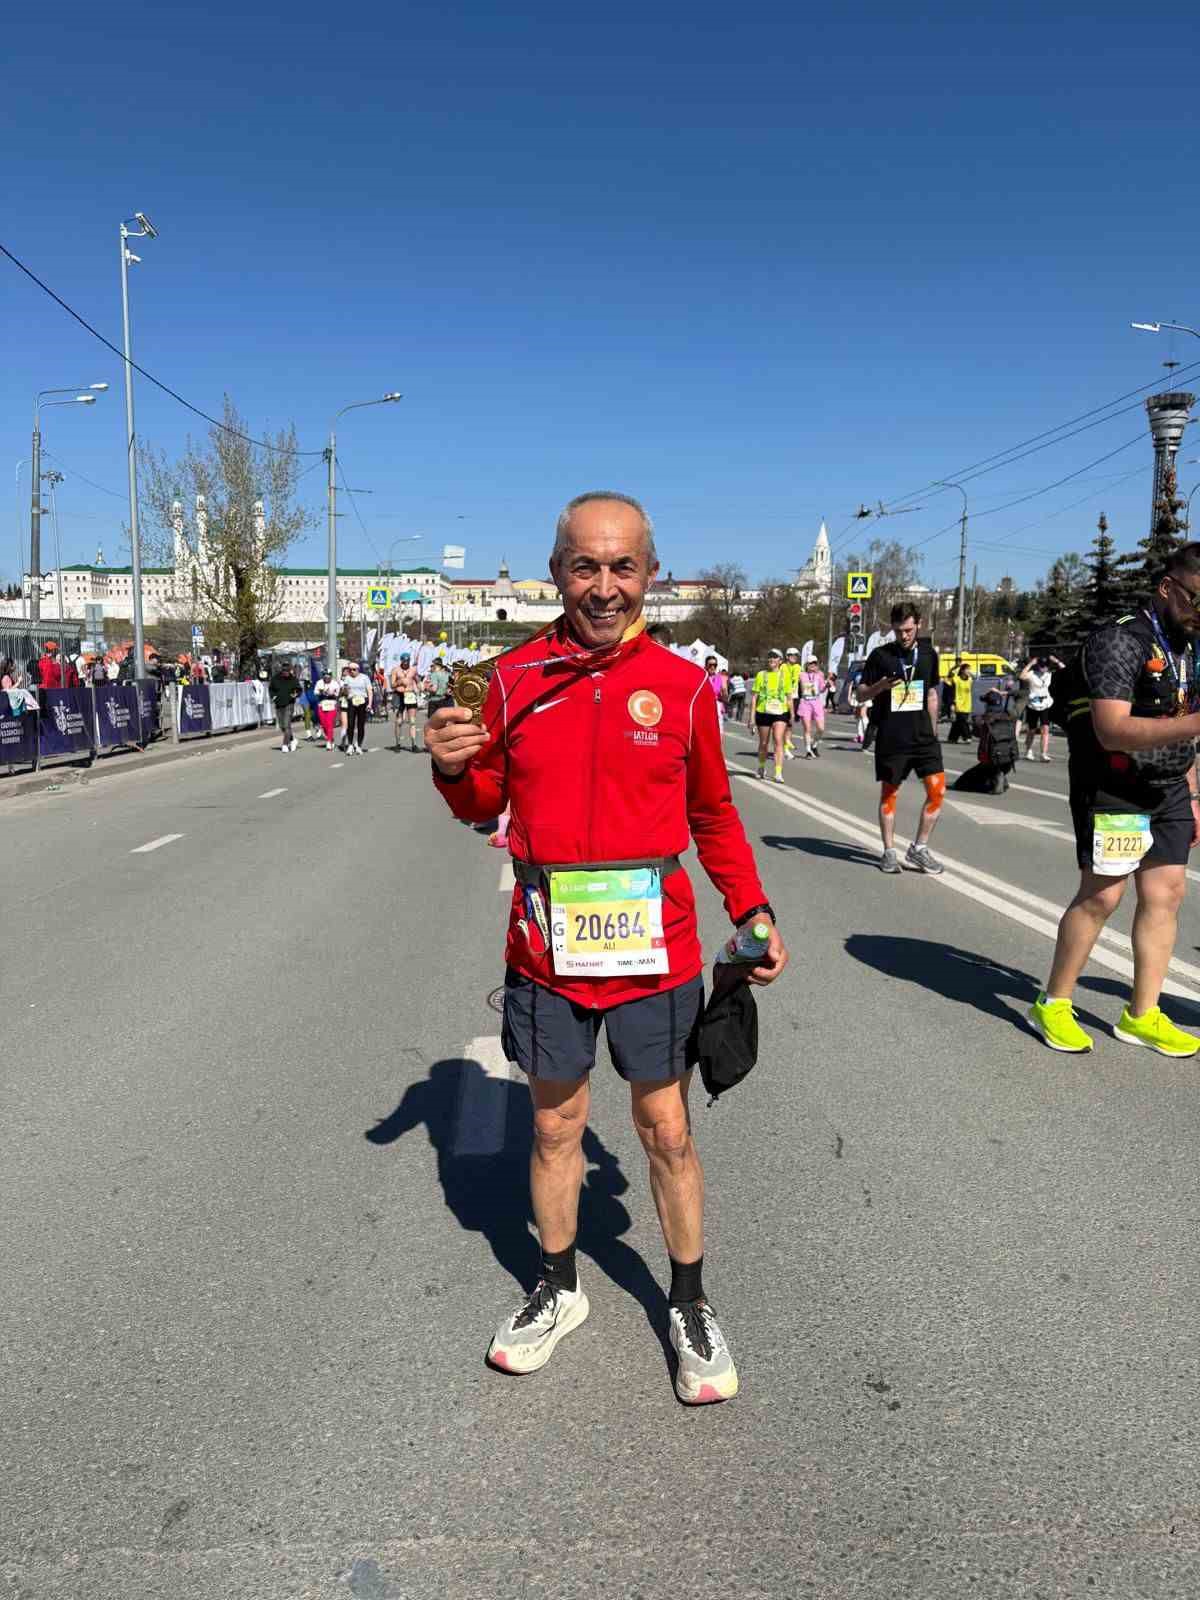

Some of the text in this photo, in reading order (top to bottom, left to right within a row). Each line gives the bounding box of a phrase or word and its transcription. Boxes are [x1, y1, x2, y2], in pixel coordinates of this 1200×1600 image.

[553, 922, 564, 936] G
[575, 911, 645, 941] 20684
[603, 942, 616, 950] ALI
